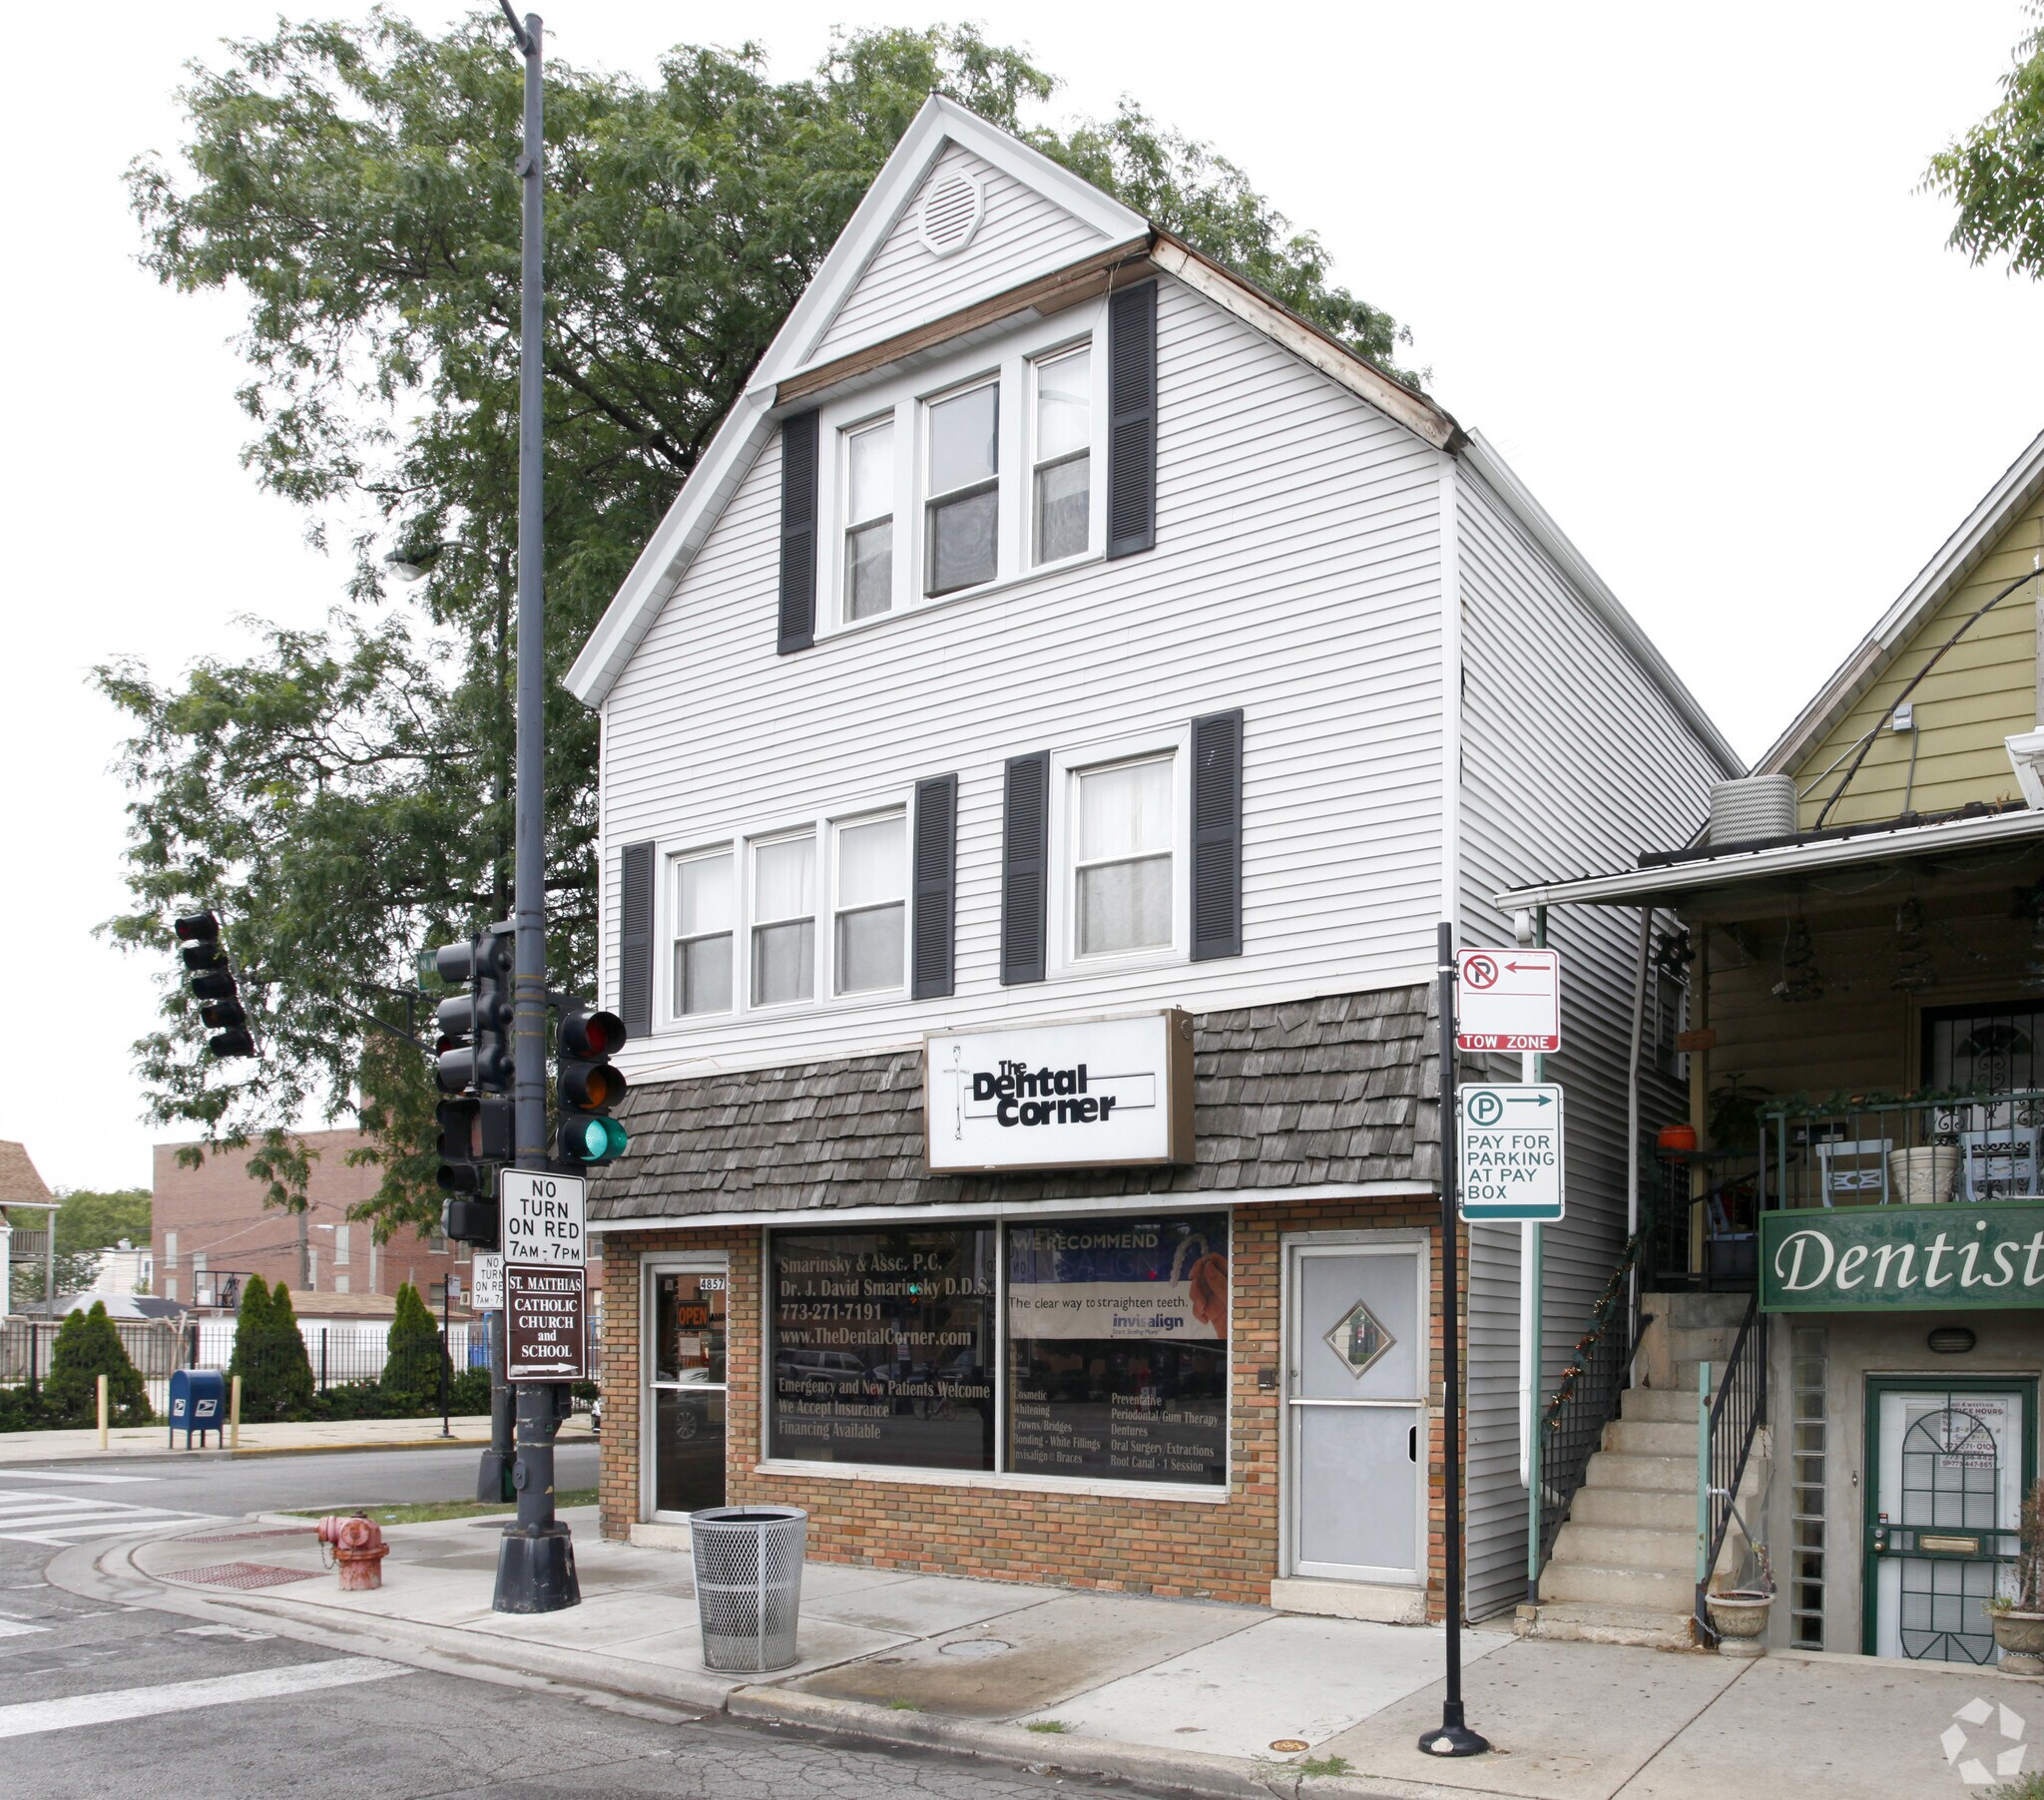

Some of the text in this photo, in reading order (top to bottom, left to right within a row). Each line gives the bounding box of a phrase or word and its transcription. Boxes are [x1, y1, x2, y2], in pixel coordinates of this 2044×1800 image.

[1464, 1035, 1550, 1050] TOW ZONE
[999, 1060, 1027, 1077] The
[973, 1064, 1088, 1102] Dental
[997, 1096, 1116, 1127] Corner
[1467, 1134, 1550, 1149] PAY FOR
[1467, 1151, 1555, 1166] PARKING
[1468, 1168, 1537, 1182] AT PAY
[532, 1179, 556, 1197] NO
[1468, 1184, 1507, 1199] BOX
[520, 1198, 568, 1218] TURN
[509, 1217, 579, 1239] ON RED
[509, 1240, 539, 1257] 7AM
[551, 1243, 580, 1260] 7PM
[1012, 1233, 1159, 1251] WE RECOMMEND
[486, 1257, 499, 1268] NO
[1775, 1219, 2044, 1291] Dentist
[780, 1257, 852, 1275] Smarinsky
[856, 1256, 867, 1272] &
[913, 1253, 943, 1271] P.C.
[475, 1281, 503, 1292] ON RE
[509, 1276, 581, 1291] ST. MATTHIAS
[701, 1279, 724, 1289] 4857
[780, 1277, 992, 1298] Dr. J. David Smarinsky D.D.S.
[514, 1298, 578, 1312] CATHOLIC
[1008, 1295, 1189, 1311] The clear way to straighten teeth.
[680, 1306, 708, 1325] OPEN
[780, 1303, 881, 1321] 773-271-7191
[519, 1315, 574, 1329] CHURCH
[1113, 1313, 1184, 1331] invisalign
[538, 1329, 557, 1341] and
[780, 1327, 972, 1346] www.TheDentalCorner.com
[521, 1344, 573, 1357] SCHOOL
[778, 1377, 990, 1398] Emergency and New Patients Welcome
[1014, 1388, 1048, 1401] Cosmetic
[1112, 1392, 1162, 1406] Preventative
[778, 1399, 889, 1418] We Accept Insurance
[1014, 1403, 1051, 1418] Whitening
[1184, 1411, 1219, 1427] Therapy
[778, 1420, 881, 1440] Financing Available
[1111, 1423, 1149, 1438] Dentures
[1013, 1434, 1044, 1448] Bonding
[1050, 1436, 1071, 1448] White
[1073, 1438, 1101, 1451] Fillings
[1111, 1439, 1129, 1452] Oral
[1056, 1453, 1083, 1465] Braces
[1110, 1454, 1130, 1468] Root
[1132, 1456, 1156, 1469] Canal
[1171, 1459, 1204, 1472] Session
